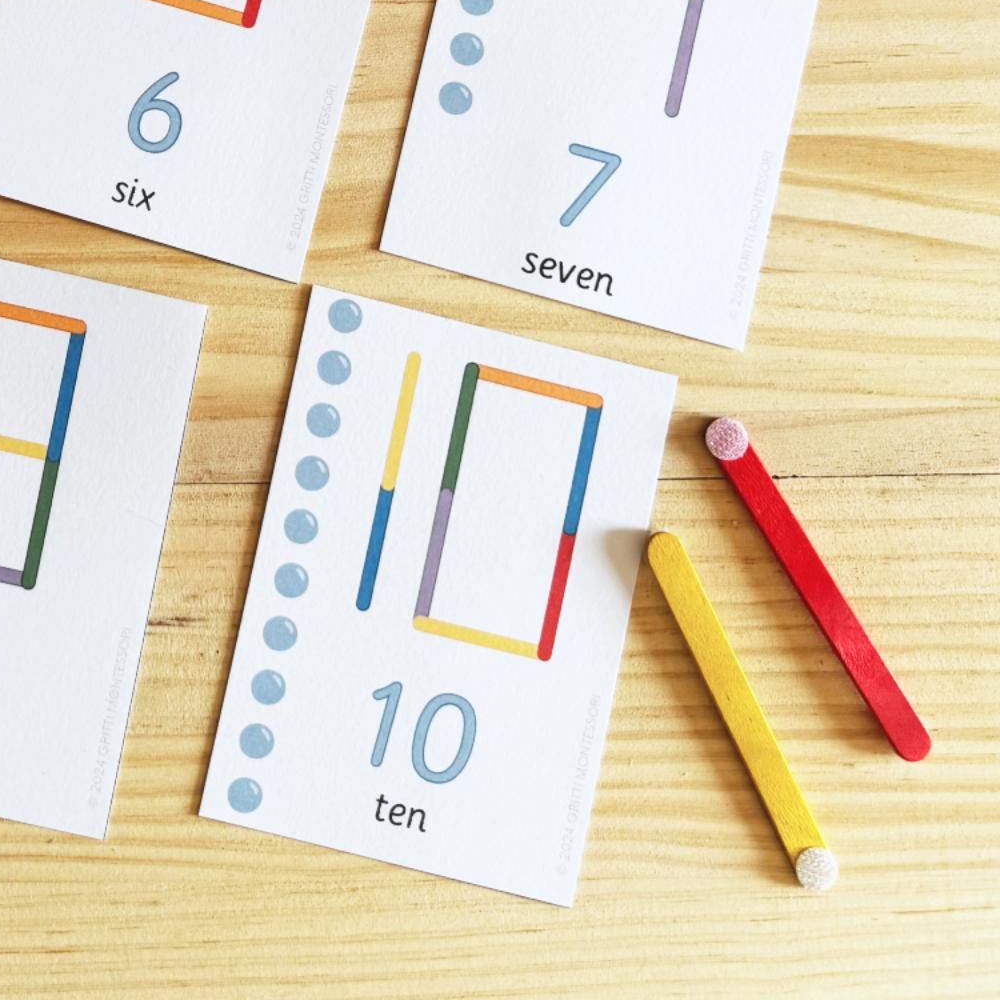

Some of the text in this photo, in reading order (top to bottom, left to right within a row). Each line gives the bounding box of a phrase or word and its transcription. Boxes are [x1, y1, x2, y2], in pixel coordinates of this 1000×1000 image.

[127, 72, 183, 156] 6
[111, 180, 156, 212] six
[289, 208, 305, 239] 2024
[298, 167, 314, 204] GRITTI
[308, 82, 337, 164] MONTESSORI
[559, 143, 623, 229] 7
[521, 252, 614, 297] seven
[369, 680, 477, 786] 10
[374, 793, 426, 833] ten
